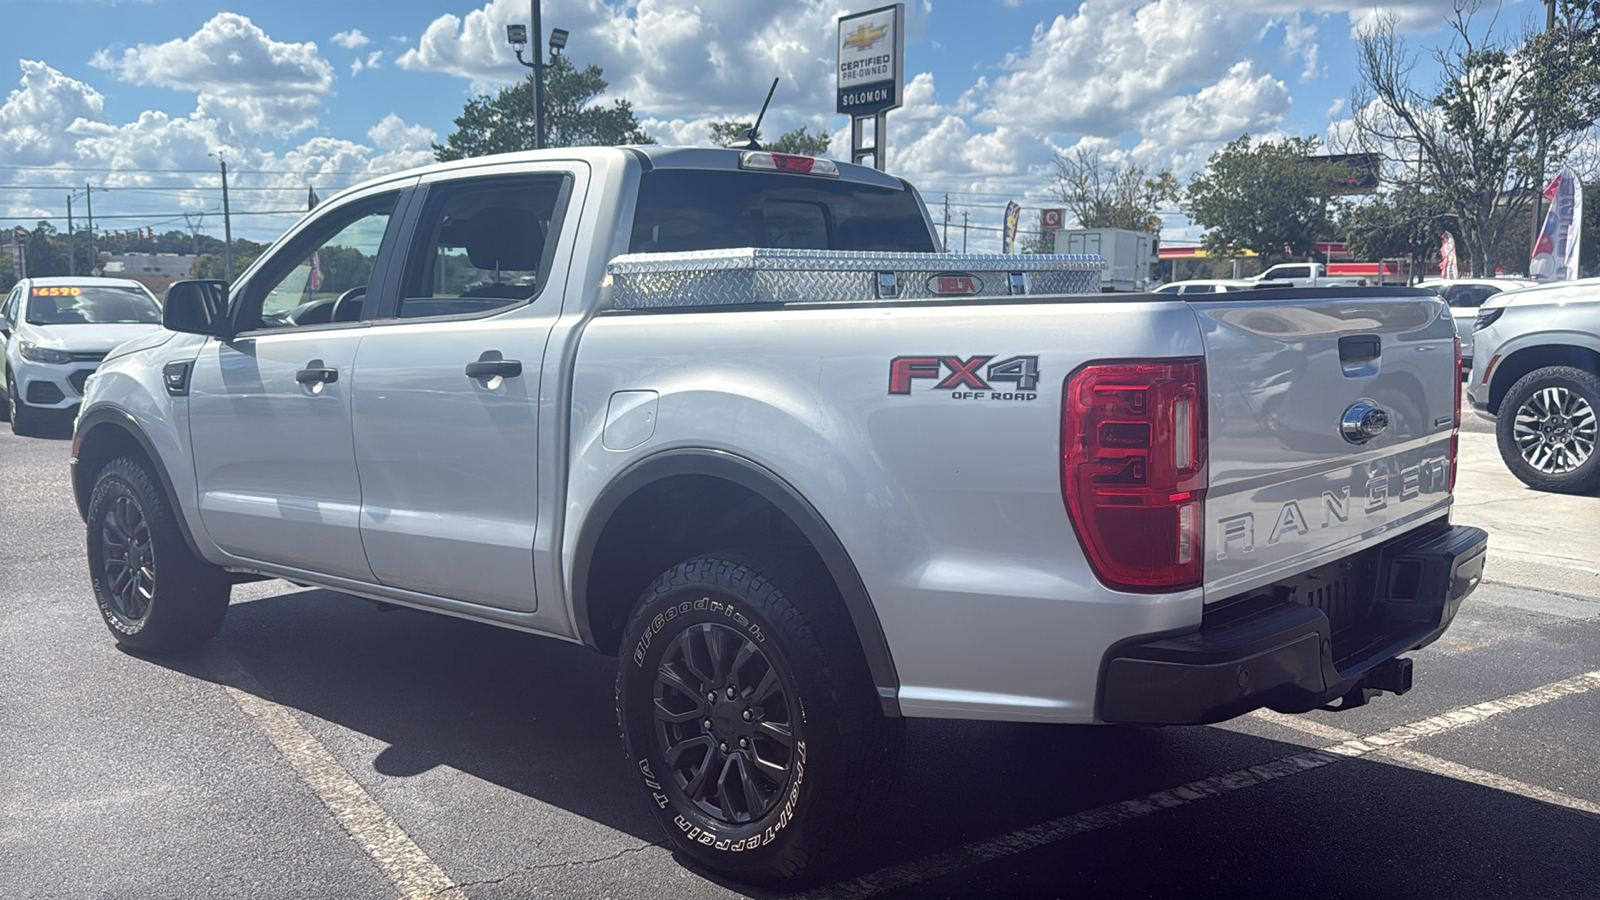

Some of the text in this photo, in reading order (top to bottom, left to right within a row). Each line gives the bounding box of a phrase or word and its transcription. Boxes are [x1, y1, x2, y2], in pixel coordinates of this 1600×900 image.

[841, 55, 890, 71] CERTIFIED
[842, 65, 888, 80] PRE-OWNED
[842, 89, 887, 106] SOLOMON
[888, 354, 1041, 396] FX4
[952, 391, 1038, 401] OFF ROAD
[1216, 455, 1449, 561] RANGER
[633, 597, 766, 668] BFGoodrich
